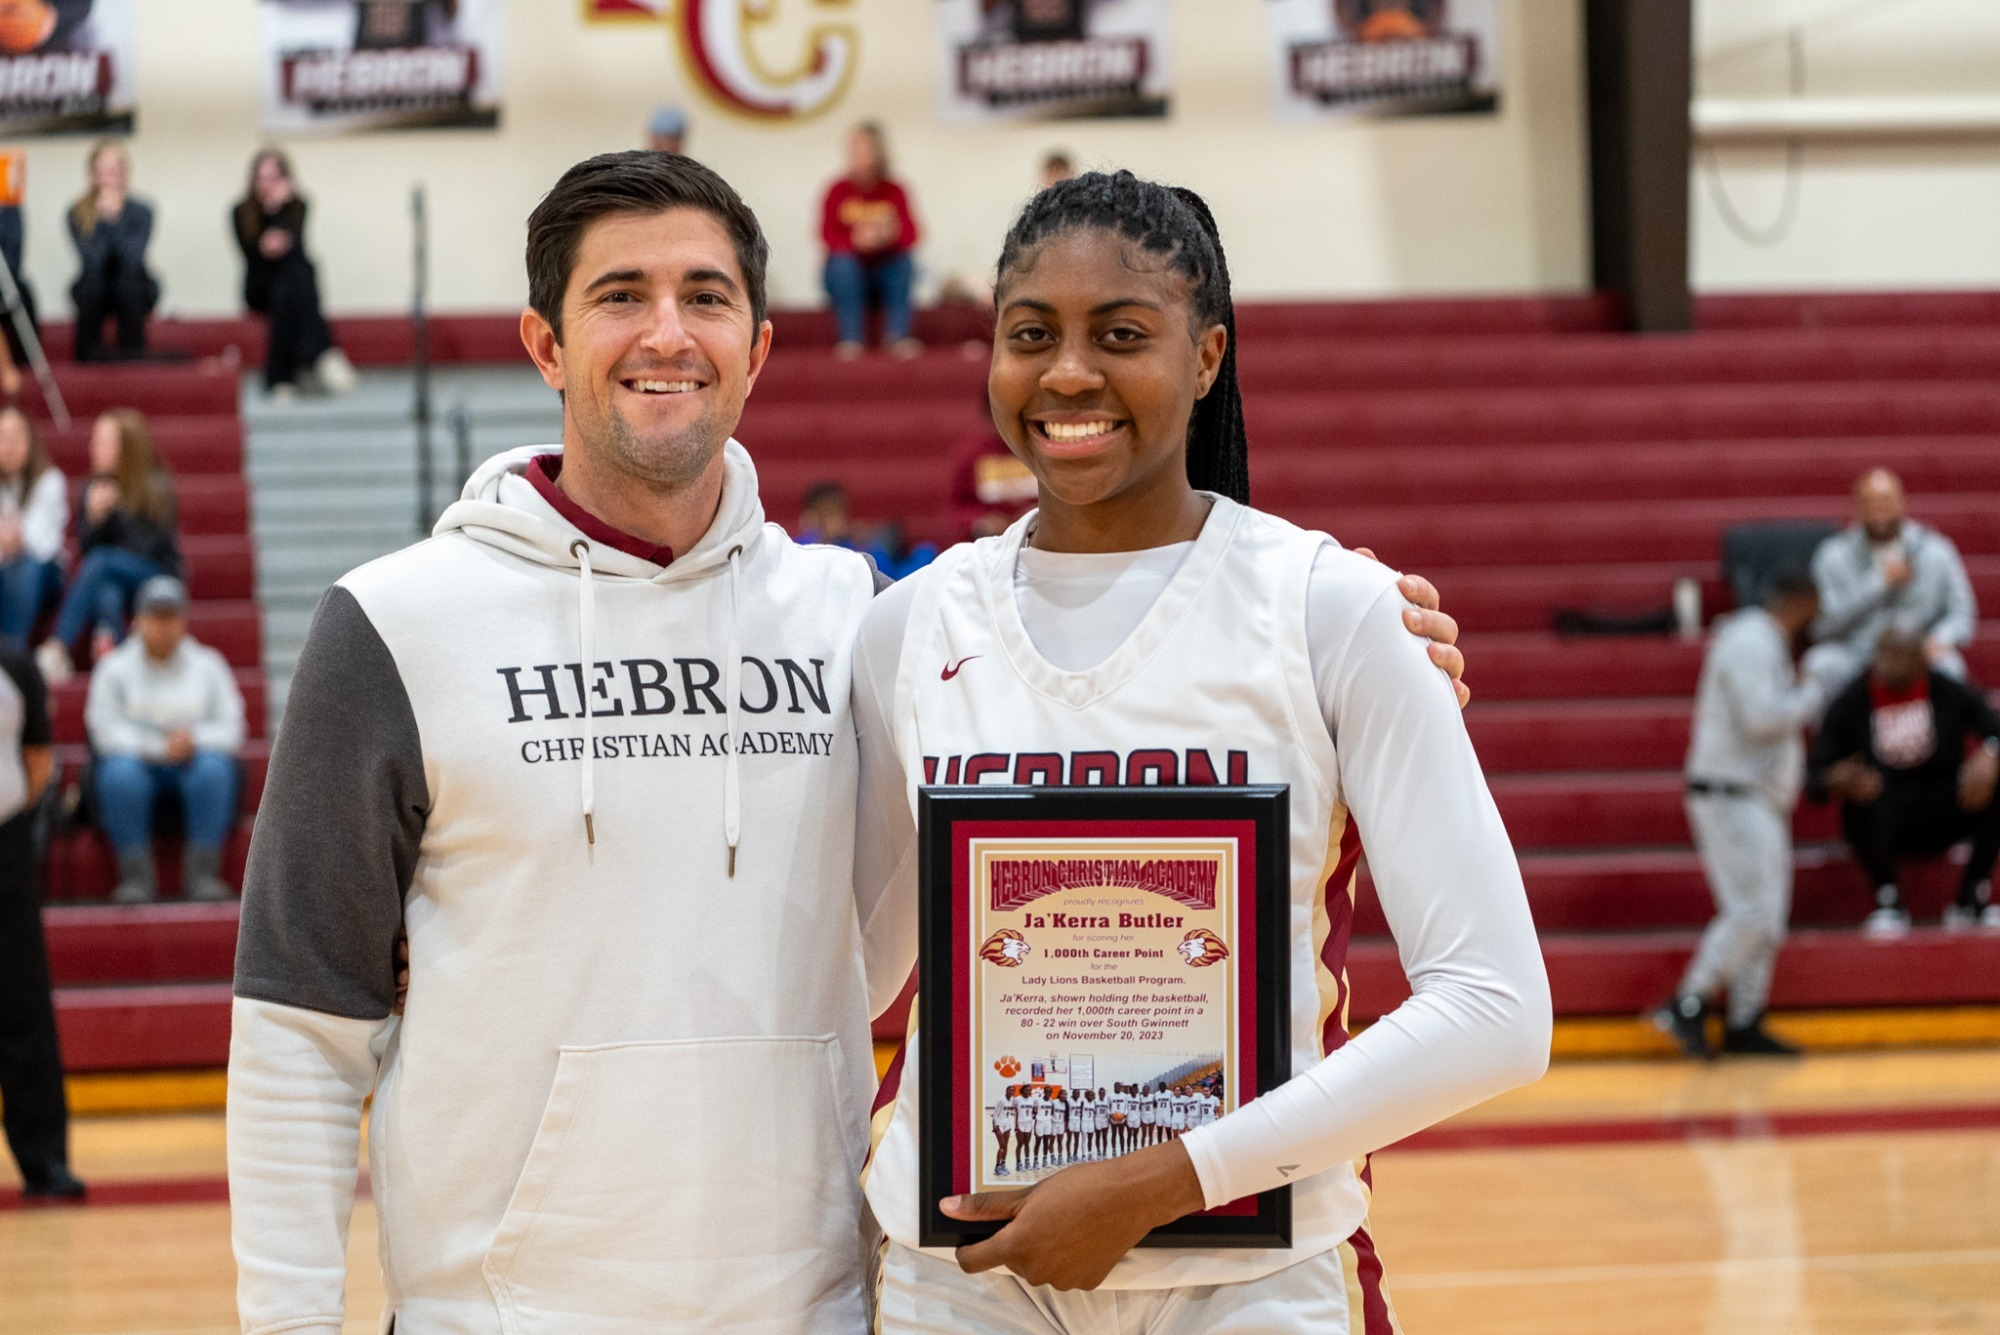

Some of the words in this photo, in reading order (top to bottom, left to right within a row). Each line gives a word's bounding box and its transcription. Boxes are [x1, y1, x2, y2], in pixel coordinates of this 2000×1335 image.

[496, 655, 832, 724] HEBRON
[520, 733, 692, 764] CHRISTIAN
[699, 731, 834, 757] ACADEMY
[990, 860, 1055, 911] HEBRON
[1057, 859, 1142, 887] CHRISTIAN
[1144, 859, 1218, 910] ACADEMY
[1063, 897, 1096, 907] proudly
[1097, 898, 1144, 907] recognizes
[1024, 913, 1110, 929] Ja'Kerra
[1118, 913, 1184, 929] Butler
[1072, 934, 1084, 942] for
[1086, 934, 1118, 944] scoring
[1120, 934, 1135, 942] her
[1044, 949, 1089, 959] 1,000th
[1093, 949, 1130, 958] Career
[1134, 949, 1164, 958] Point
[1090, 963, 1101, 971] for
[1104, 963, 1118, 971] the
[1022, 976, 1047, 986] Lady
[1050, 976, 1078, 985] Lions
[1081, 976, 1136, 985] Basketball
[1139, 976, 1186, 986] Program.
[1000, 993, 1047, 1004] Ja'Kerra,
[1050, 993, 1086, 1003] shown
[1088, 993, 1129, 1005] holding
[1132, 993, 1149, 1003] the
[1151, 993, 1209, 1004] basketball,
[1005, 1006, 1053, 1015] recorded
[1056, 1006, 1073, 1015] her
[1077, 1006, 1115, 1017] 1,000th
[1153, 1006, 1182, 1017] point
[1184, 1006, 1195, 1015] in
[1020, 1018, 1034, 1028] 80
[1043, 1018, 1056, 1028] 22
[1058, 1018, 1077, 1028] win
[1079, 1020, 1103, 1028] over
[1106, 1018, 1138, 1028] South
[1140, 1018, 1189, 1028] Gwinnett
[1046, 1032, 1060, 1040] on
[1062, 1031, 1117, 1040] November
[1120, 1031, 1136, 1041] 20,
[1138, 1031, 1164, 1040] 2023
